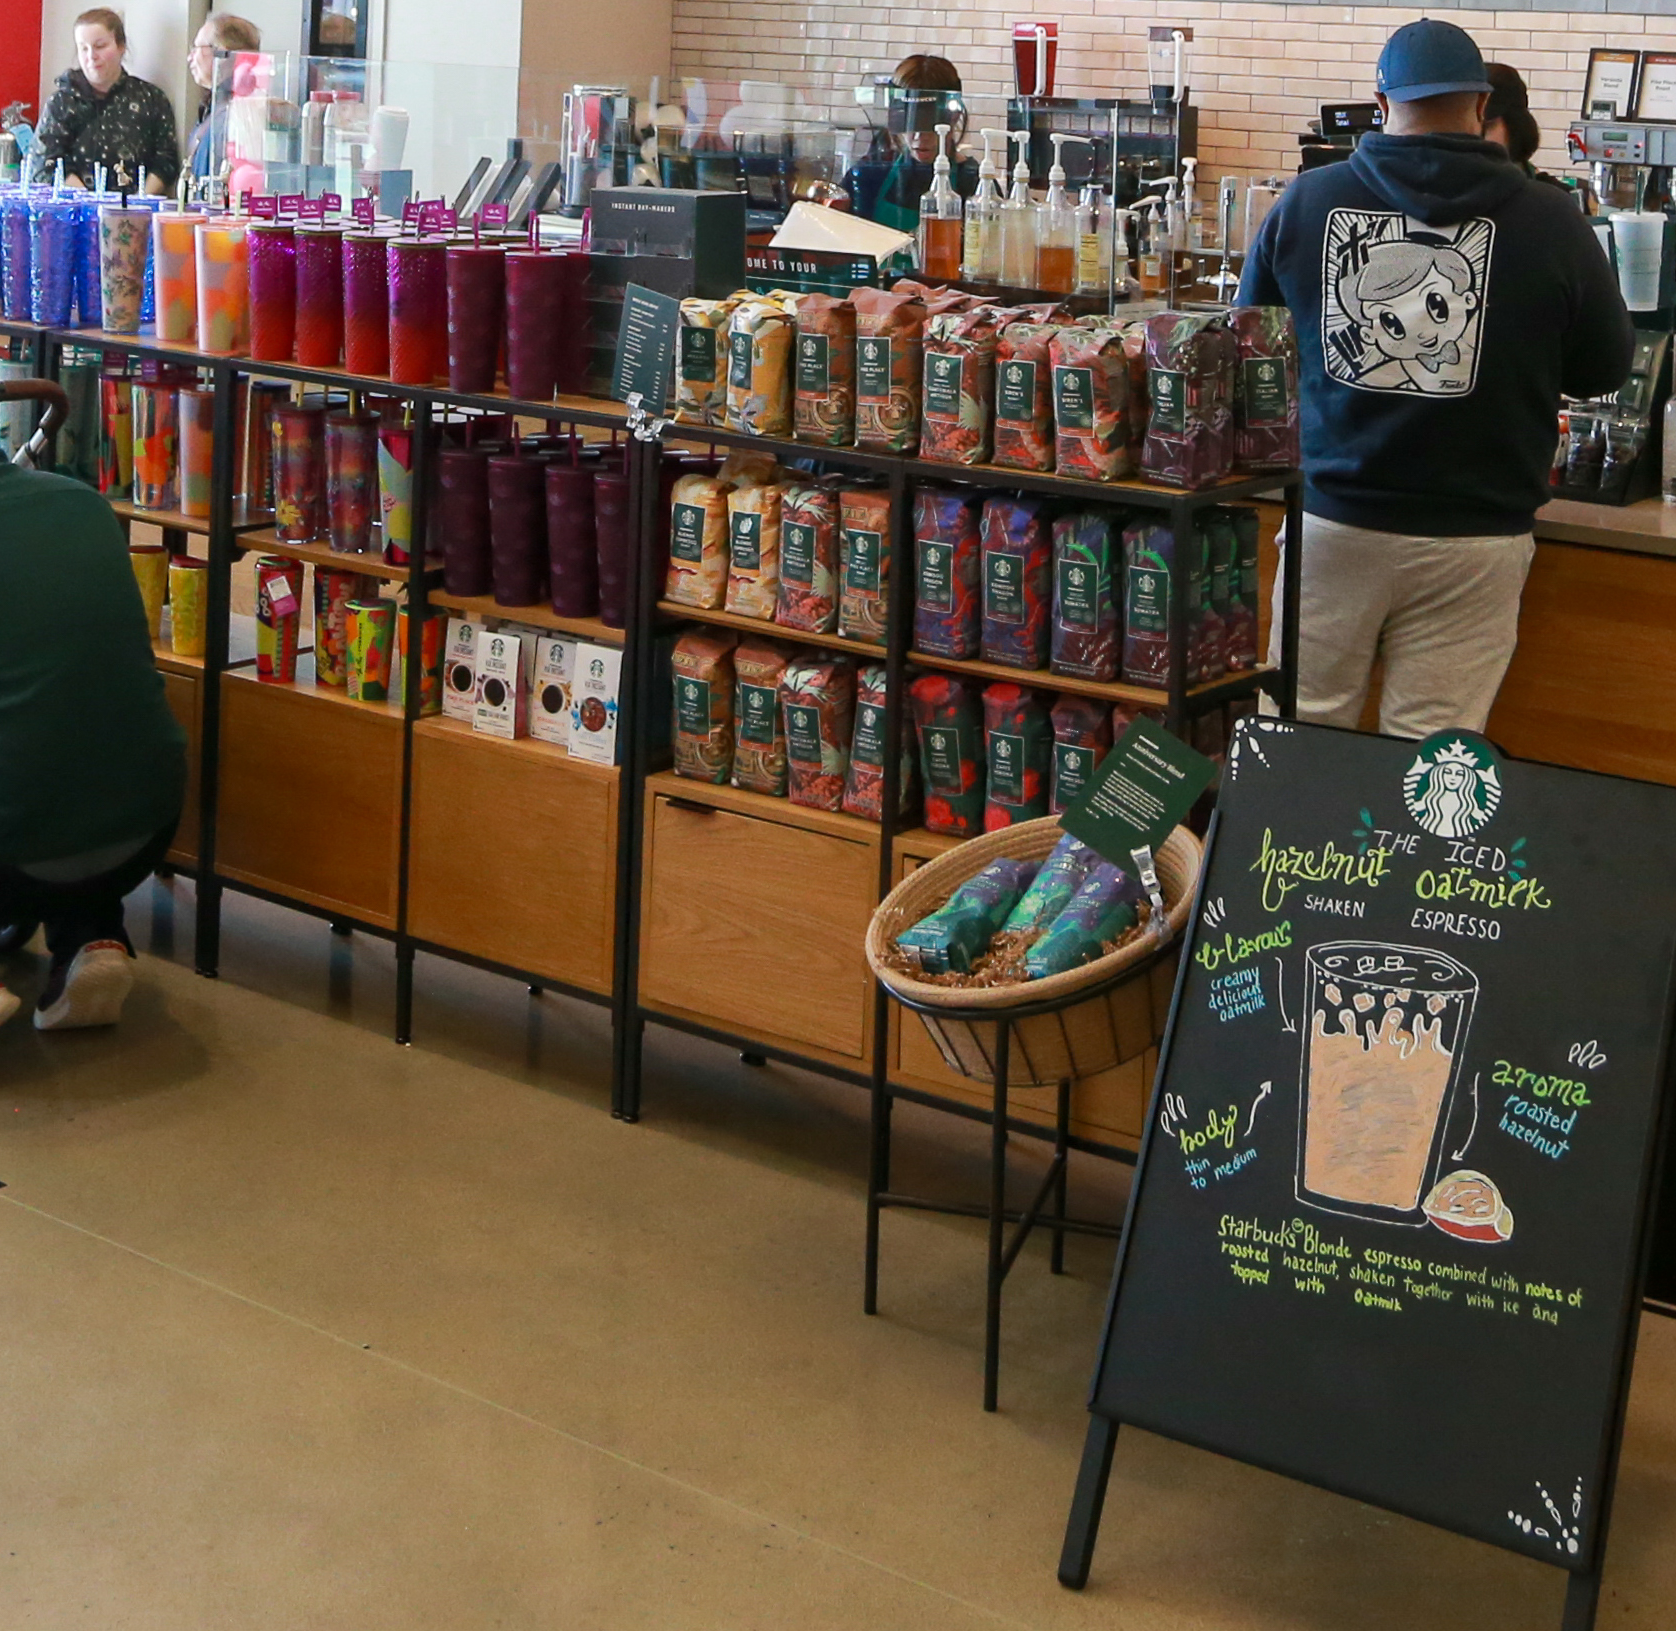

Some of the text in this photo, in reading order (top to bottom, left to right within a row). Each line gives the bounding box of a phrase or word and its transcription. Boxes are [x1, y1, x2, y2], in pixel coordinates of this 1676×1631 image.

[612, 202, 676, 214] INSTANT DAY-MAKERS
[772, 260, 785, 271] TO
[789, 261, 817, 273] YOUR
[1439, 379, 1466, 389] Funko
[1132, 741, 1168, 769] Anniversary
[1250, 827, 1393, 912] hazelnut
[1373, 829, 1506, 872] THE ICED
[1304, 894, 1501, 940] SHAKEN ESPRESSO
[1208, 982, 1262, 1009] delicious
[1210, 966, 1260, 992] creamy
[1219, 993, 1266, 1022] oatmilk
[1491, 1060, 1592, 1107] aroma
[1180, 1104, 1240, 1156] body
[1497, 1112, 1571, 1160] hazelnut
[1504, 1094, 1578, 1136] roasted
[1184, 1156, 1211, 1178] thin
[1190, 1146, 1258, 1190] to medium
[1220, 1239, 1270, 1265] roasted
[1349, 1265, 1396, 1289] shaken
[1403, 1276, 1453, 1302] together
[1466, 1290, 1495, 1311] with
[1502, 1296, 1520, 1316] ice
[1532, 1304, 1559, 1326] and
[1230, 1261, 1270, 1287] topped
[1294, 1275, 1325, 1296] with
[1304, 1224, 1352, 1260] Blonde
[1364, 1246, 1422, 1273] espresso
[1428, 1258, 1488, 1287] combined
[1491, 1271, 1520, 1294] with
[1525, 1280, 1564, 1304] notes
[1568, 1288, 1584, 1310] of
